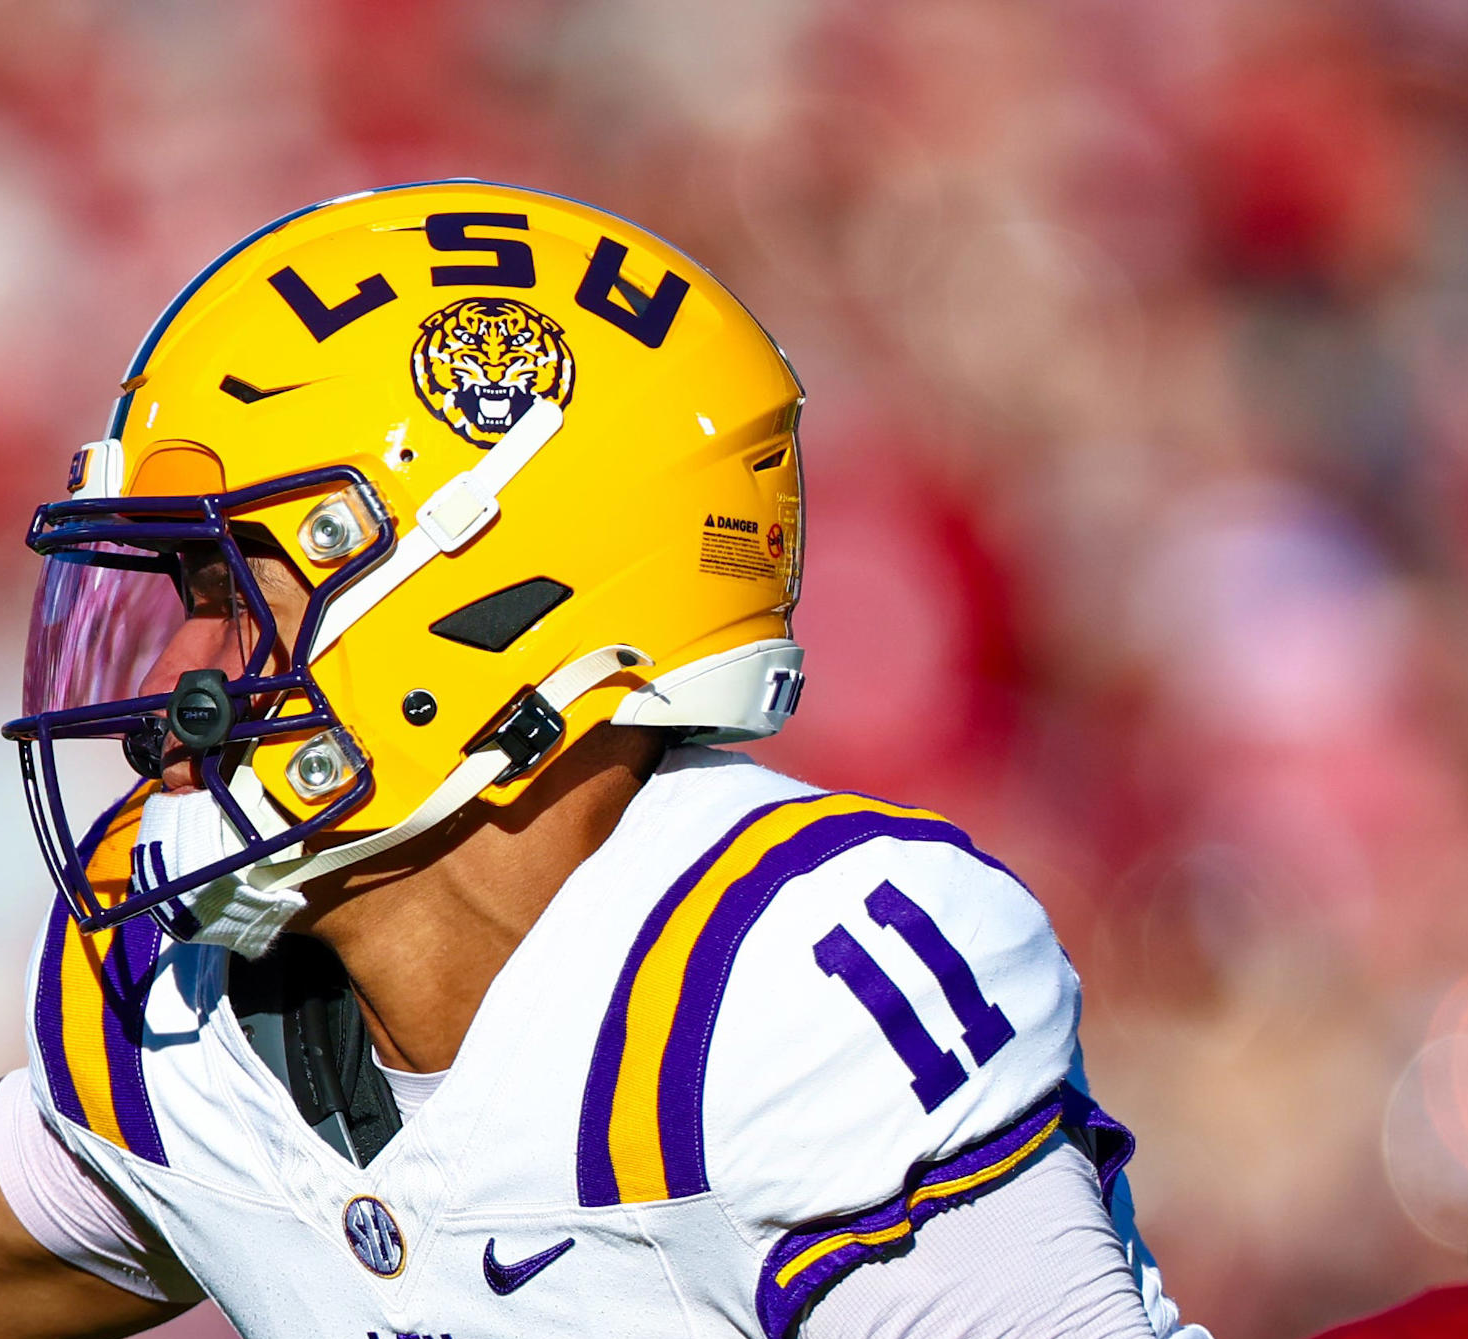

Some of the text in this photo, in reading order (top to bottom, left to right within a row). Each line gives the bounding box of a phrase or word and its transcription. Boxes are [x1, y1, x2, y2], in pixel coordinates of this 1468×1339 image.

[267, 211, 691, 349] LSU
[717, 515, 759, 535] DANGER
[812, 878, 1016, 1115] 11
